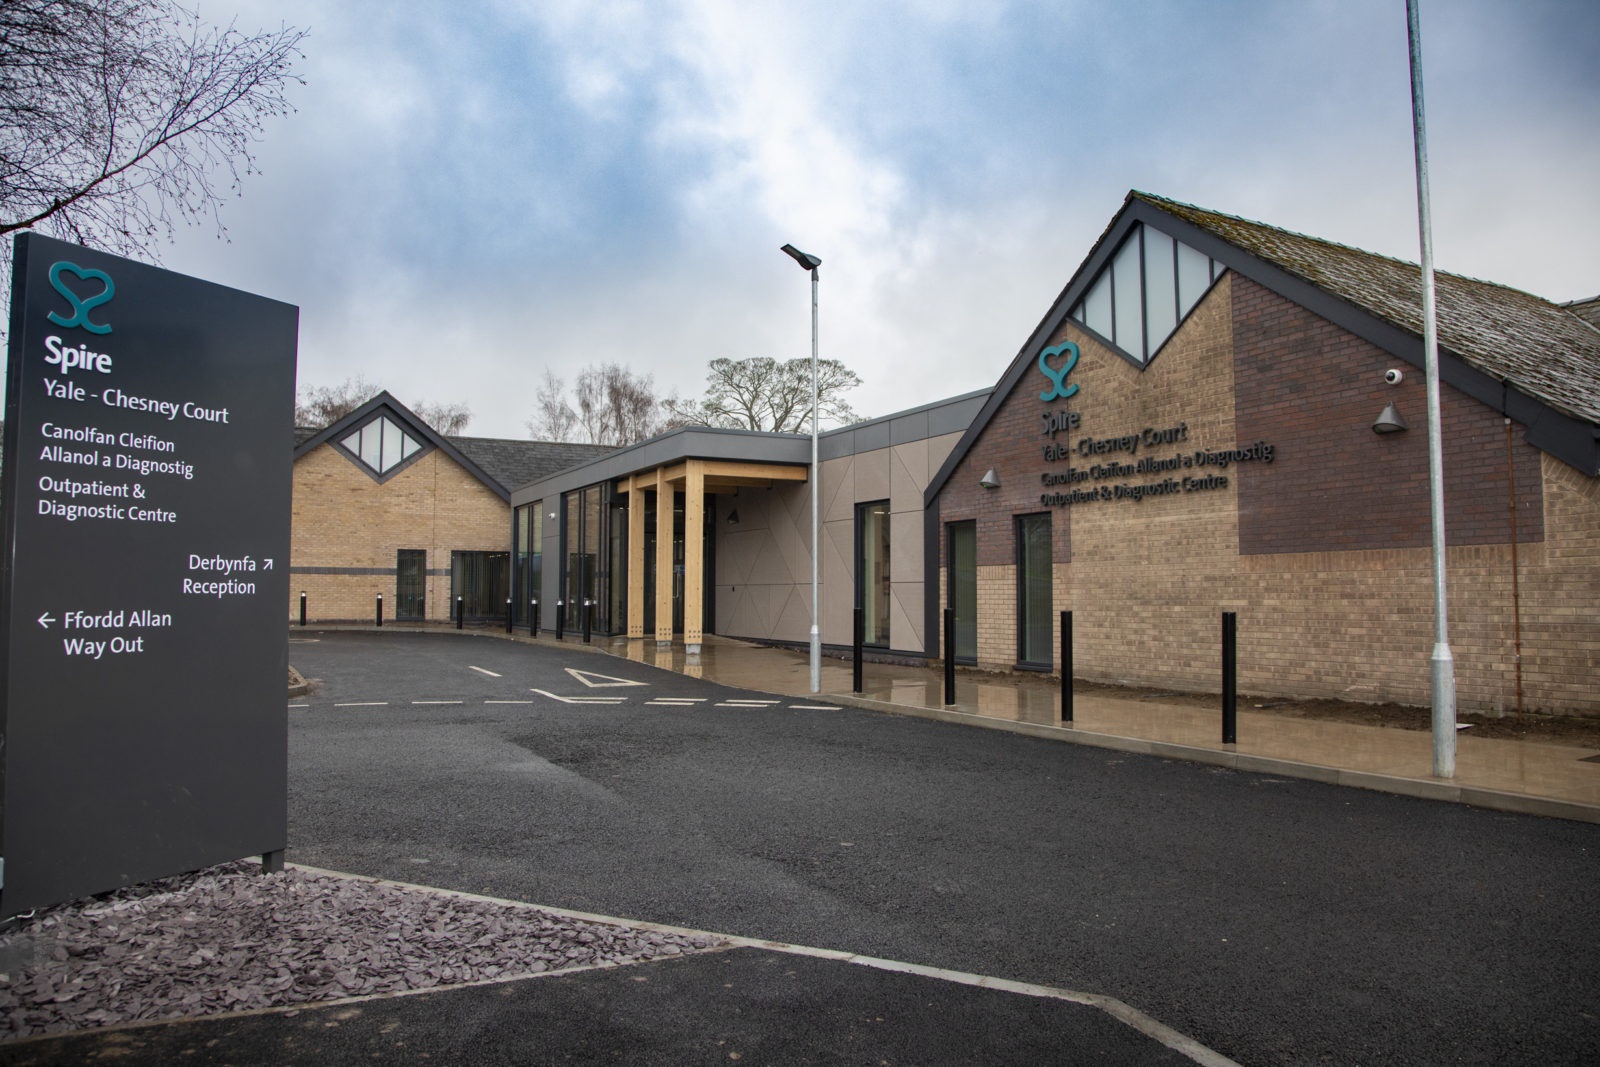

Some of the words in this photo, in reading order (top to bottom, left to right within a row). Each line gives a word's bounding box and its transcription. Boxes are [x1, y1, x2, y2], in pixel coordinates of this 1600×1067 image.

[44, 336, 112, 374] Spire
[44, 378, 86, 401] Yale
[103, 389, 180, 420] Chesney
[183, 402, 229, 423] Court
[41, 423, 115, 445] Canolfan
[119, 433, 174, 452] Cleifion
[1042, 411, 1080, 439] Spire
[1042, 445, 1068, 462] Yale
[1078, 434, 1139, 455] Chesney
[1142, 422, 1187, 447] Court
[40, 446, 98, 466] Allanol
[103, 456, 111, 467] a
[116, 454, 194, 480] Diagnostig
[1041, 468, 1088, 486] Canolfan
[1090, 463, 1135, 480] Cleifion
[1136, 454, 1181, 474] Allanol
[1183, 455, 1192, 468] a
[1195, 441, 1275, 468] Diagnostig
[39, 477, 130, 498] Outpatient
[133, 484, 146, 498] &
[1041, 487, 1099, 506] Outpatient
[1101, 486, 1112, 500] &
[1114, 479, 1179, 502] Diagnostic
[1182, 474, 1227, 493] Centre
[38, 500, 124, 521] Diagnostic
[128, 507, 176, 523] Centre
[188, 555, 257, 576] Derbynfa
[183, 579, 256, 599] Reception
[65, 611, 123, 628] Ffordd
[129, 610, 172, 627] Allan
[64, 639, 107, 660] Way
[110, 637, 144, 653] Out
